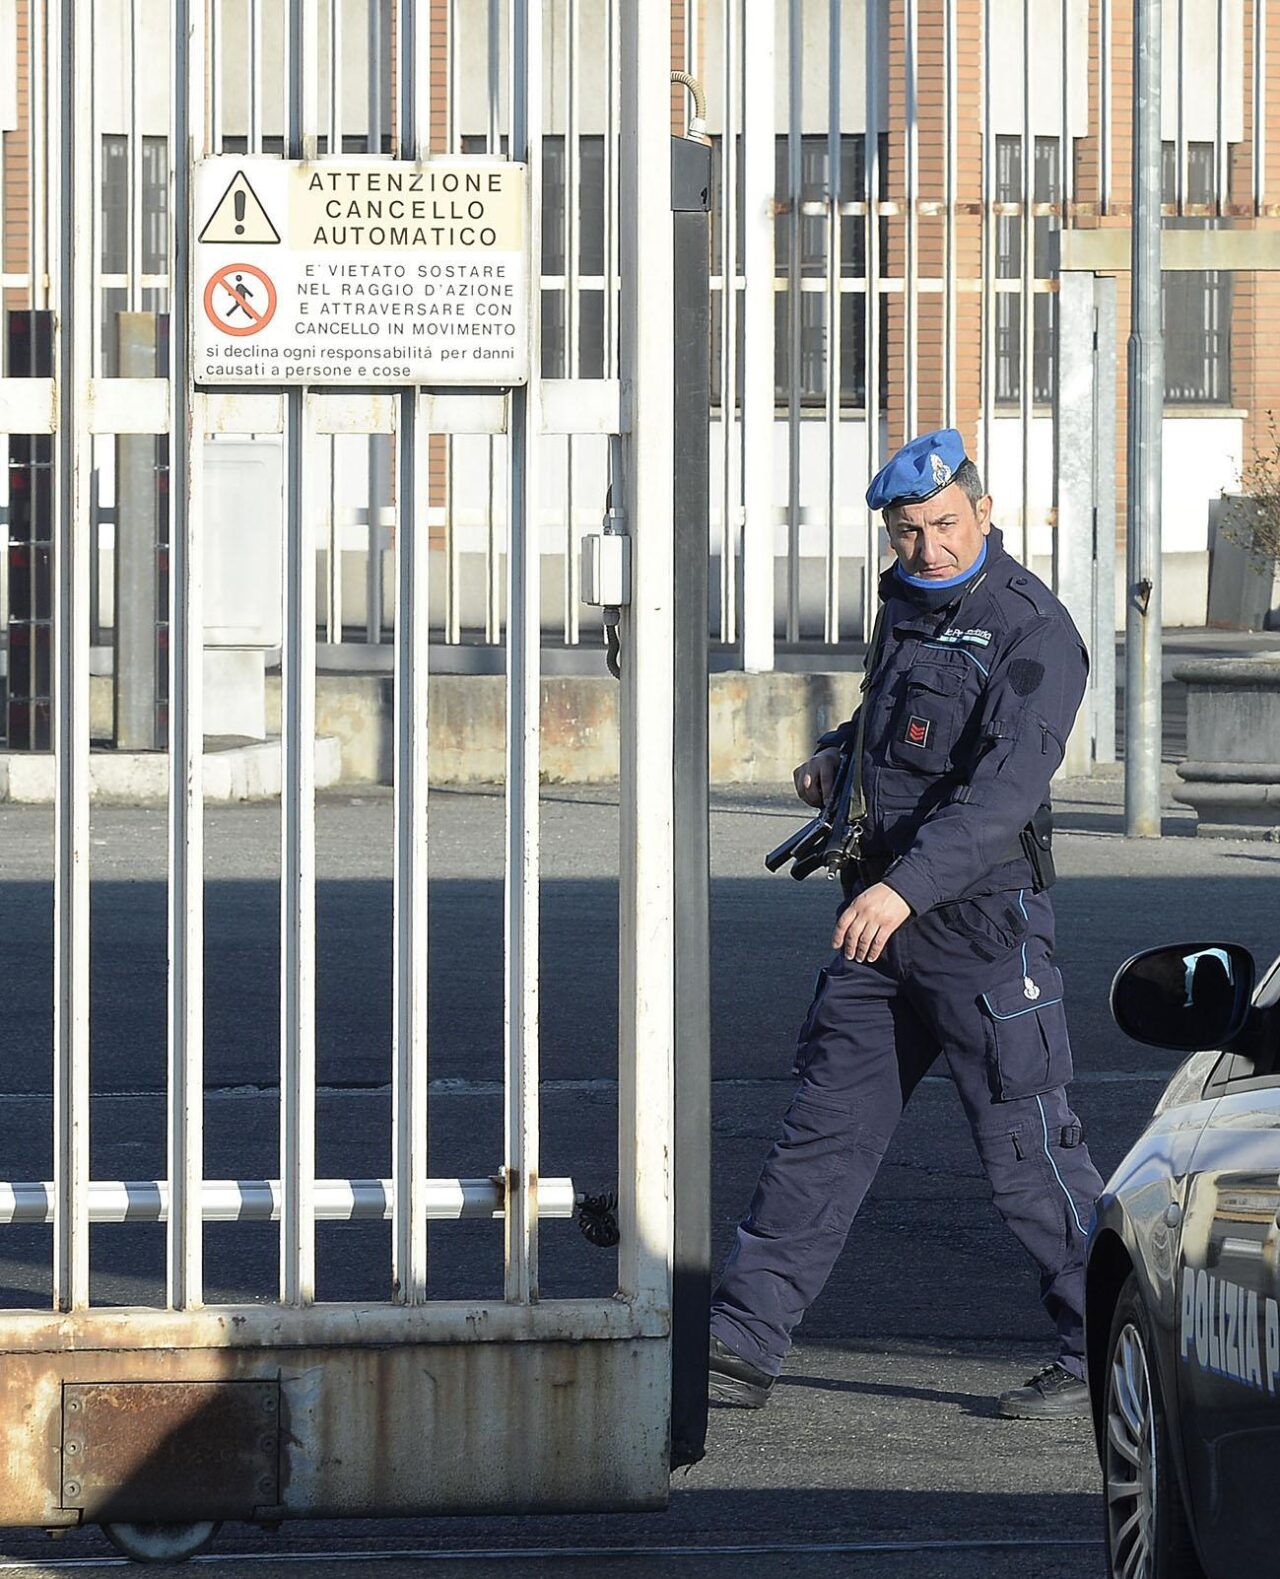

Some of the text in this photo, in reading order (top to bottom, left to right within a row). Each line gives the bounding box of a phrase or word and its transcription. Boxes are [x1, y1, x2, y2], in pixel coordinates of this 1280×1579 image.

[308, 172, 502, 193] ATTENZIONE
[325, 199, 485, 220] CANCELLO
[313, 226, 497, 246] AUTOMATICO
[328, 264, 406, 278] VIETATO
[417, 265, 506, 278] SOSTARE
[297, 283, 514, 297] NEL RAGGIO D'AZIONE
[299, 302, 512, 316] E ATTRAVERSARE CON
[294, 321, 516, 336] CANCELLO IN MOVIMENTO
[206, 344, 219, 358] si
[223, 344, 279, 358] declina
[283, 345, 316, 361] ogni
[440, 349, 467, 362] per
[472, 346, 514, 360] danni
[205, 363, 411, 379] causati a persone e cose
[1181, 1266, 1263, 1390] POLIZIA
